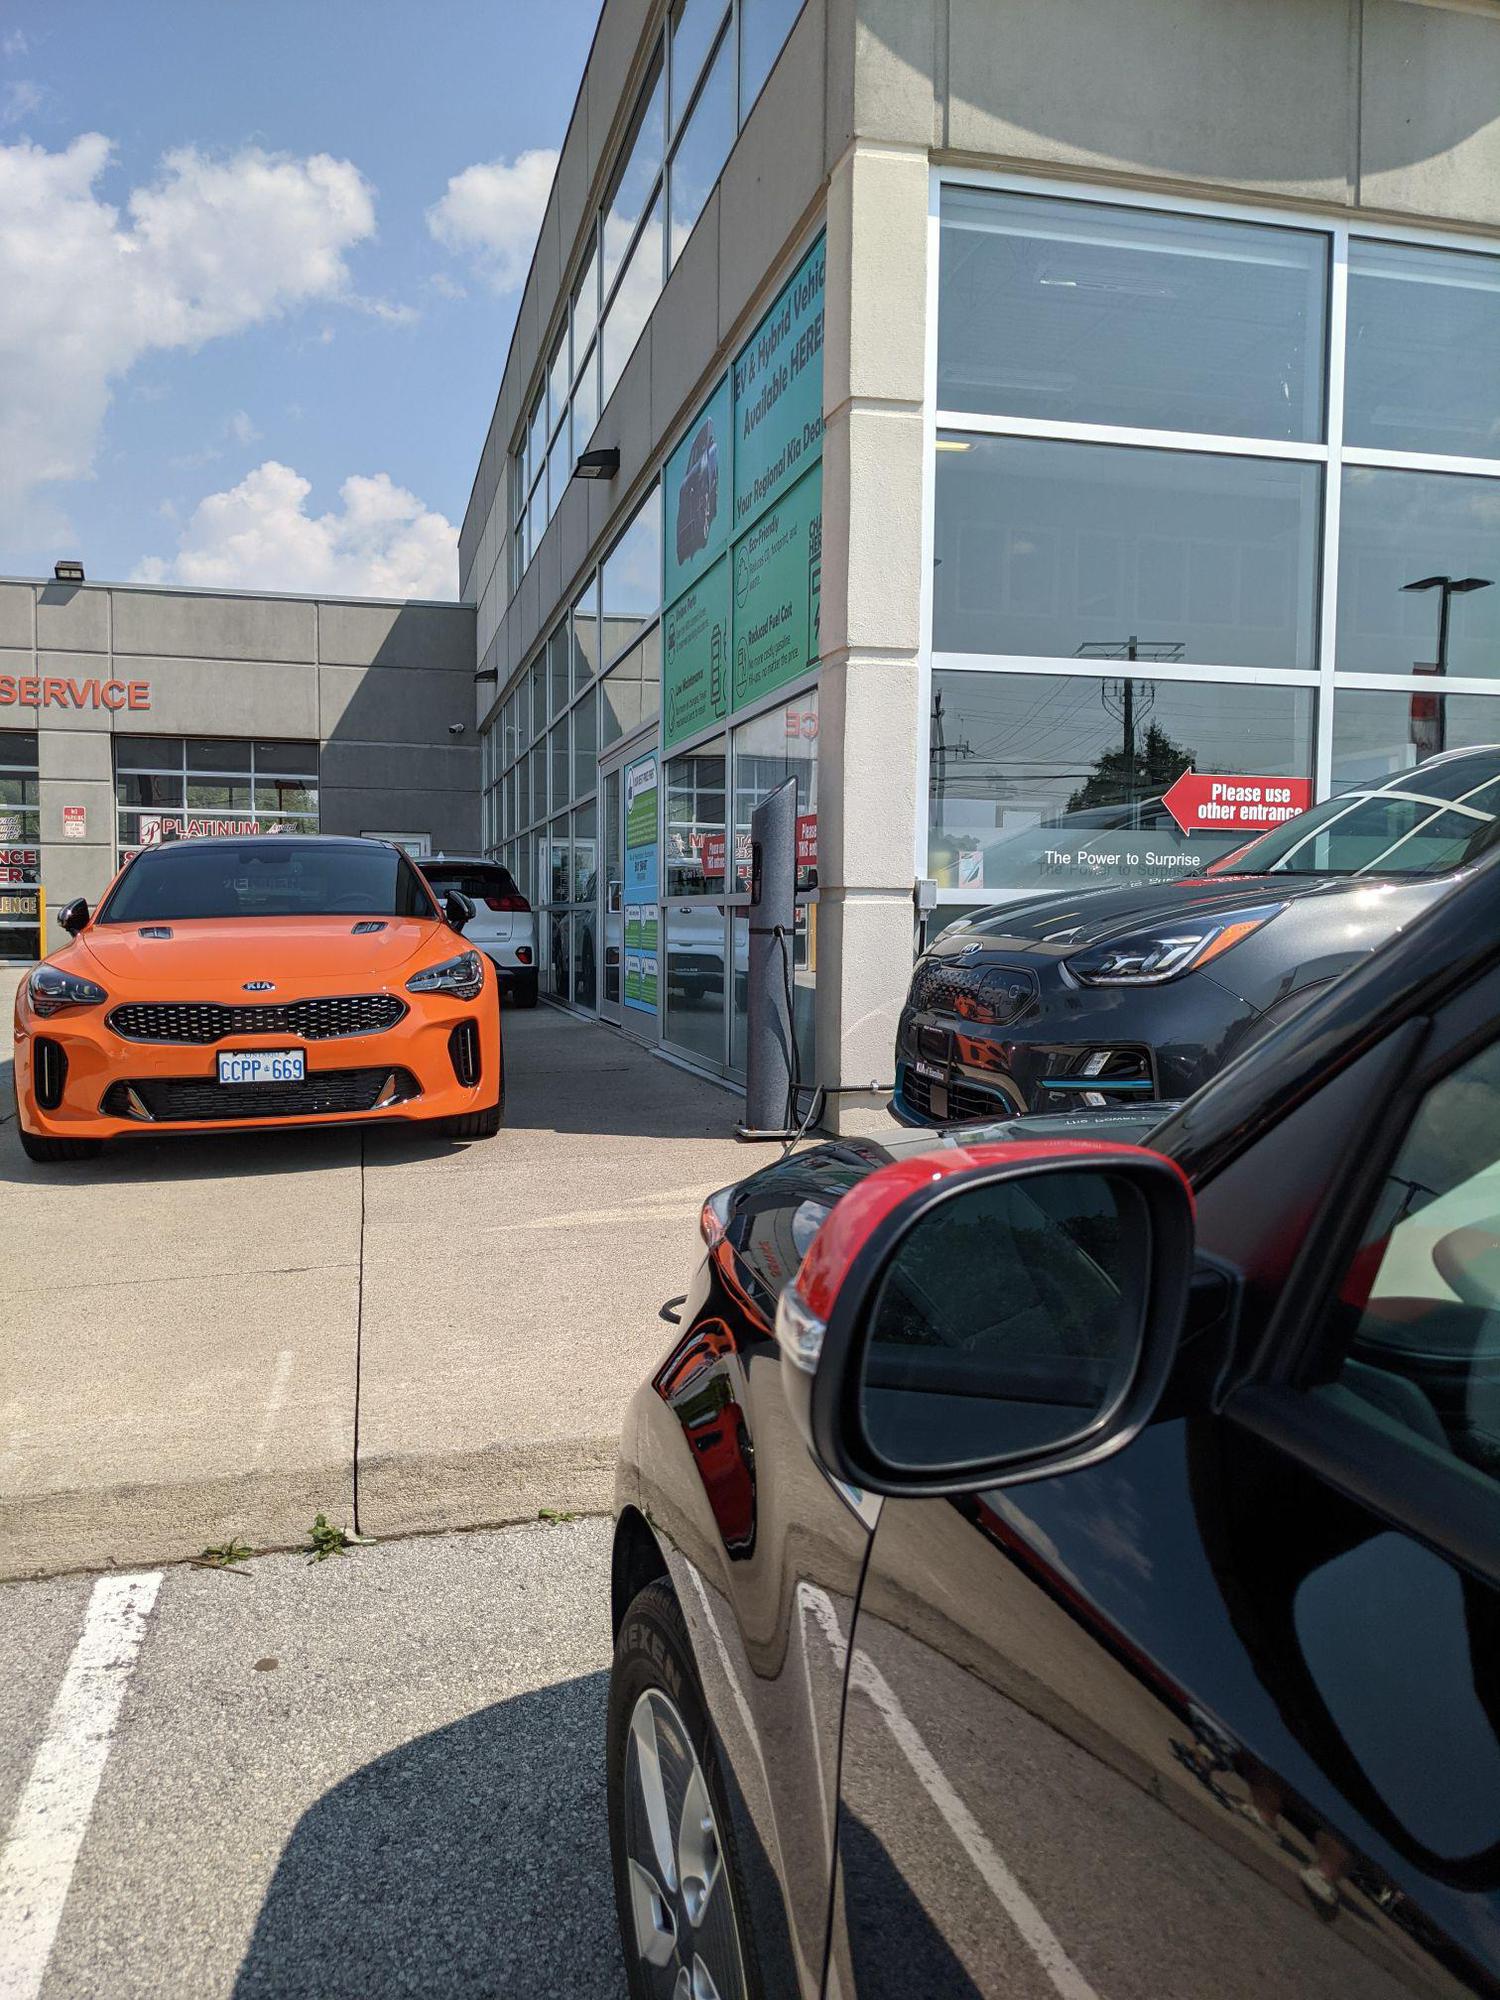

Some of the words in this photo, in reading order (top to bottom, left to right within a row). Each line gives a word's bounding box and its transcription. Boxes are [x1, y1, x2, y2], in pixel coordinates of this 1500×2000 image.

[735, 361, 747, 402] EV
[758, 296, 791, 372] Hybrid
[743, 364, 788, 440] Available
[737, 491, 752, 520] Your
[754, 447, 785, 503] Regional
[787, 436, 801, 467] Kia
[749, 515, 779, 553] Eco-Friendly
[769, 608, 780, 632] Fuel
[781, 601, 793, 622] Cost
[0, 676, 151, 710] SERVICE
[1212, 783, 1261, 801] Please
[1265, 788, 1291, 803] use
[1198, 802, 1236, 820] other
[162, 818, 260, 836] PLATINUM
[1045, 851, 1071, 865] The
[1078, 851, 1120, 865] Power
[1127, 853, 1139, 865] to
[1145, 852, 1201, 868] Surprise
[246, 981, 273, 991] KIA
[221, 1060, 261, 1081] CCPP
[273, 1059, 302, 1080] 669
